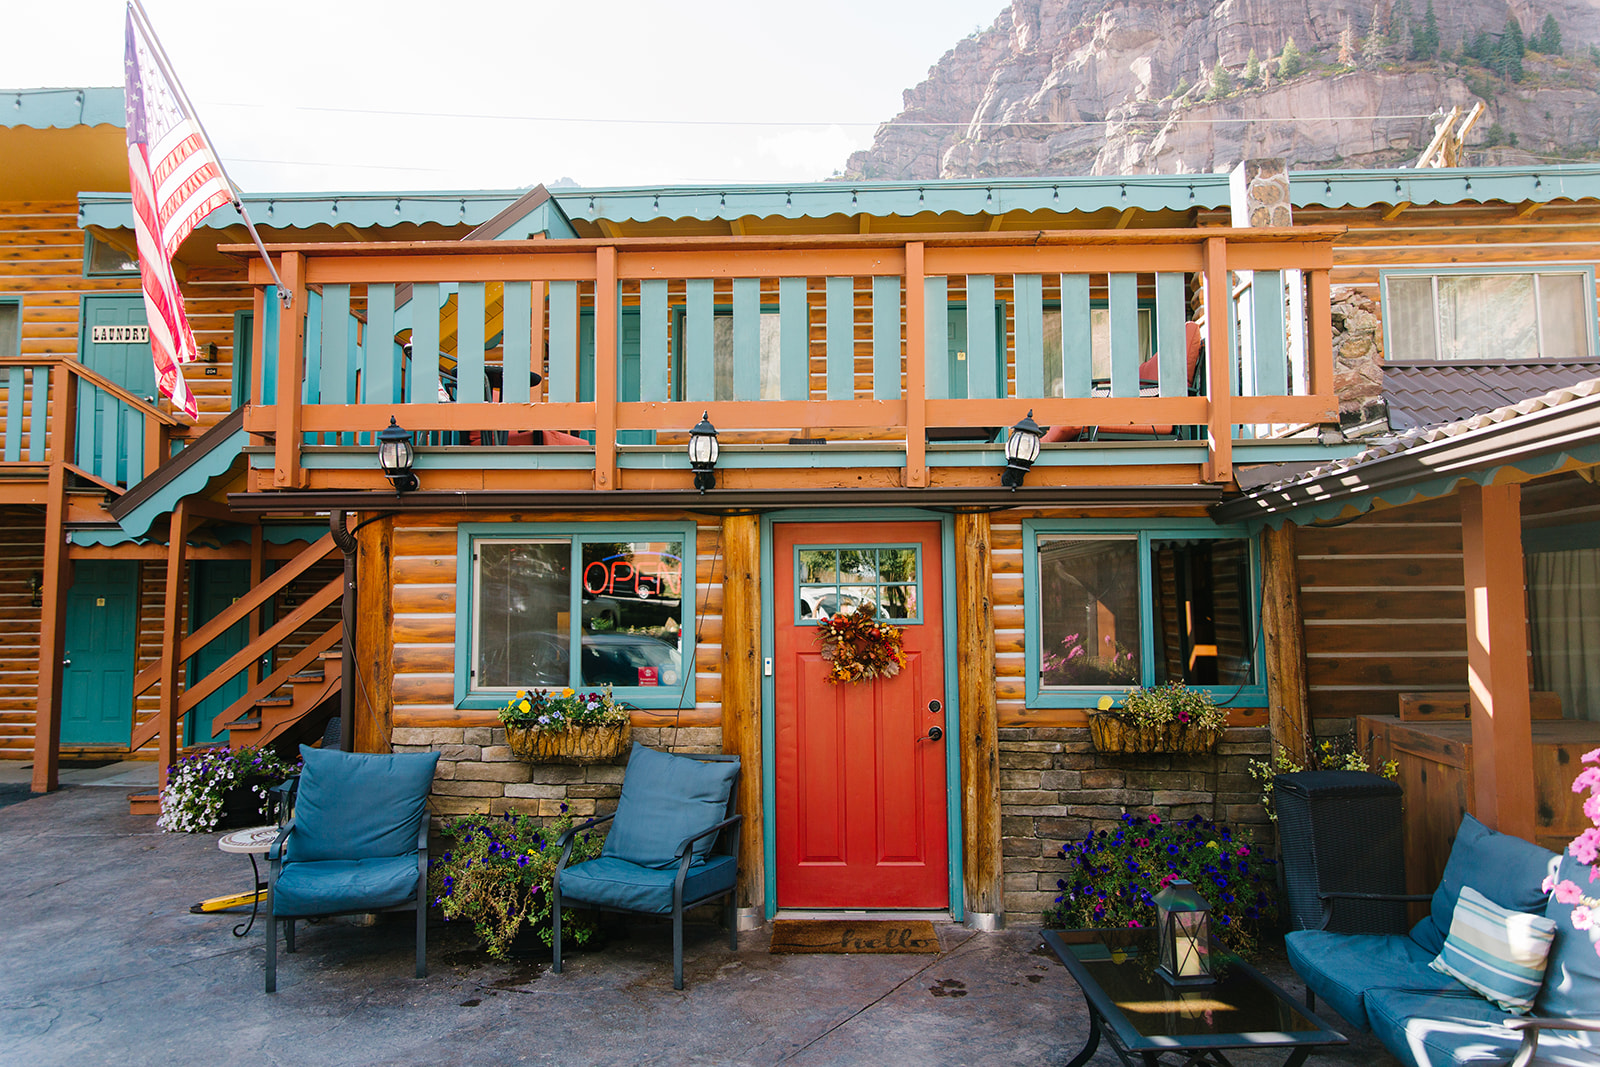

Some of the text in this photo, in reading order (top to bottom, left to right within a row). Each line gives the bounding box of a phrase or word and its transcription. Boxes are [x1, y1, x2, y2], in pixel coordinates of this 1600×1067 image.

[93, 328, 147, 340] LAUNDRY
[584, 561, 682, 594] OPEN
[841, 928, 930, 949] hello
